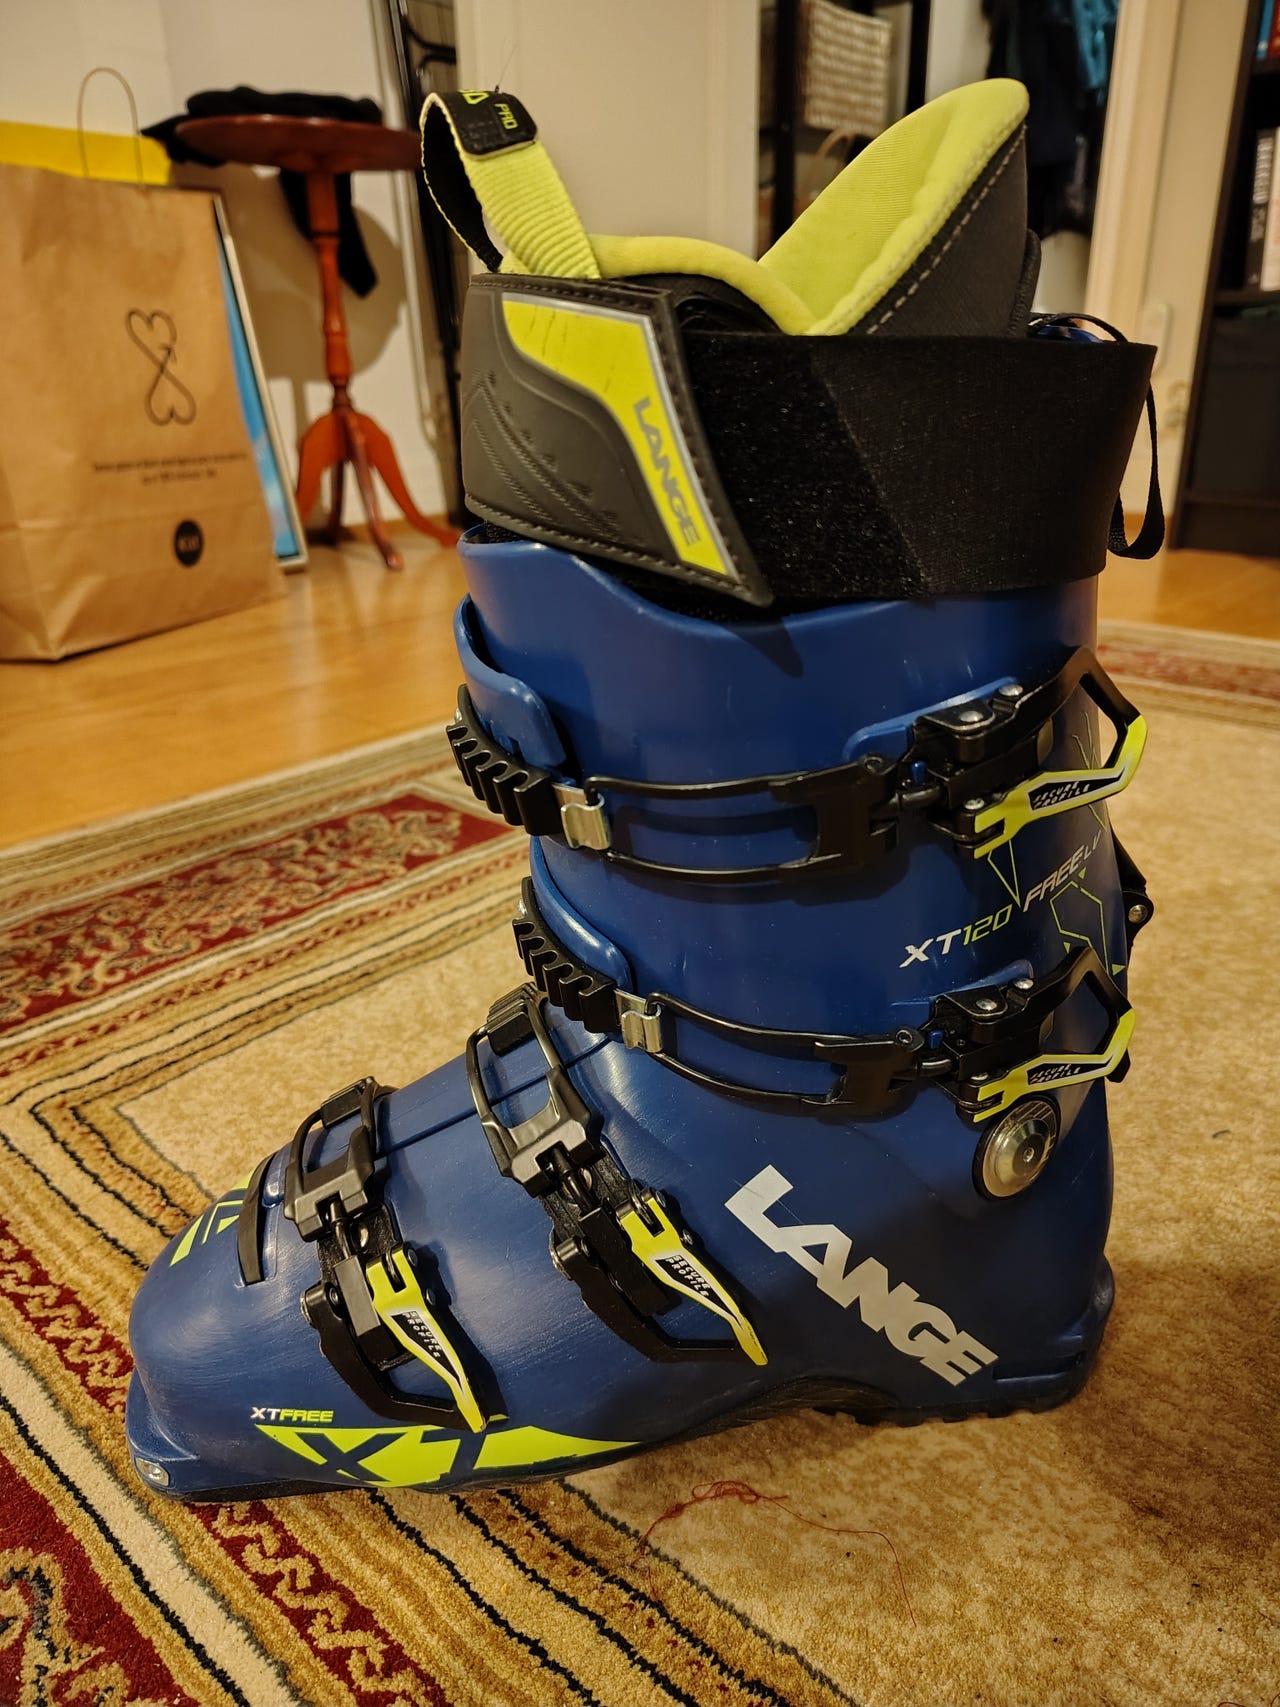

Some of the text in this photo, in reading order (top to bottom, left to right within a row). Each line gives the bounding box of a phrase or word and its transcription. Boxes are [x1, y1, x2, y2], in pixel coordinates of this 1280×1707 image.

[494, 103, 518, 130] PRO
[633, 396, 700, 546] LANGE
[724, 1164, 999, 1387] LANGE
